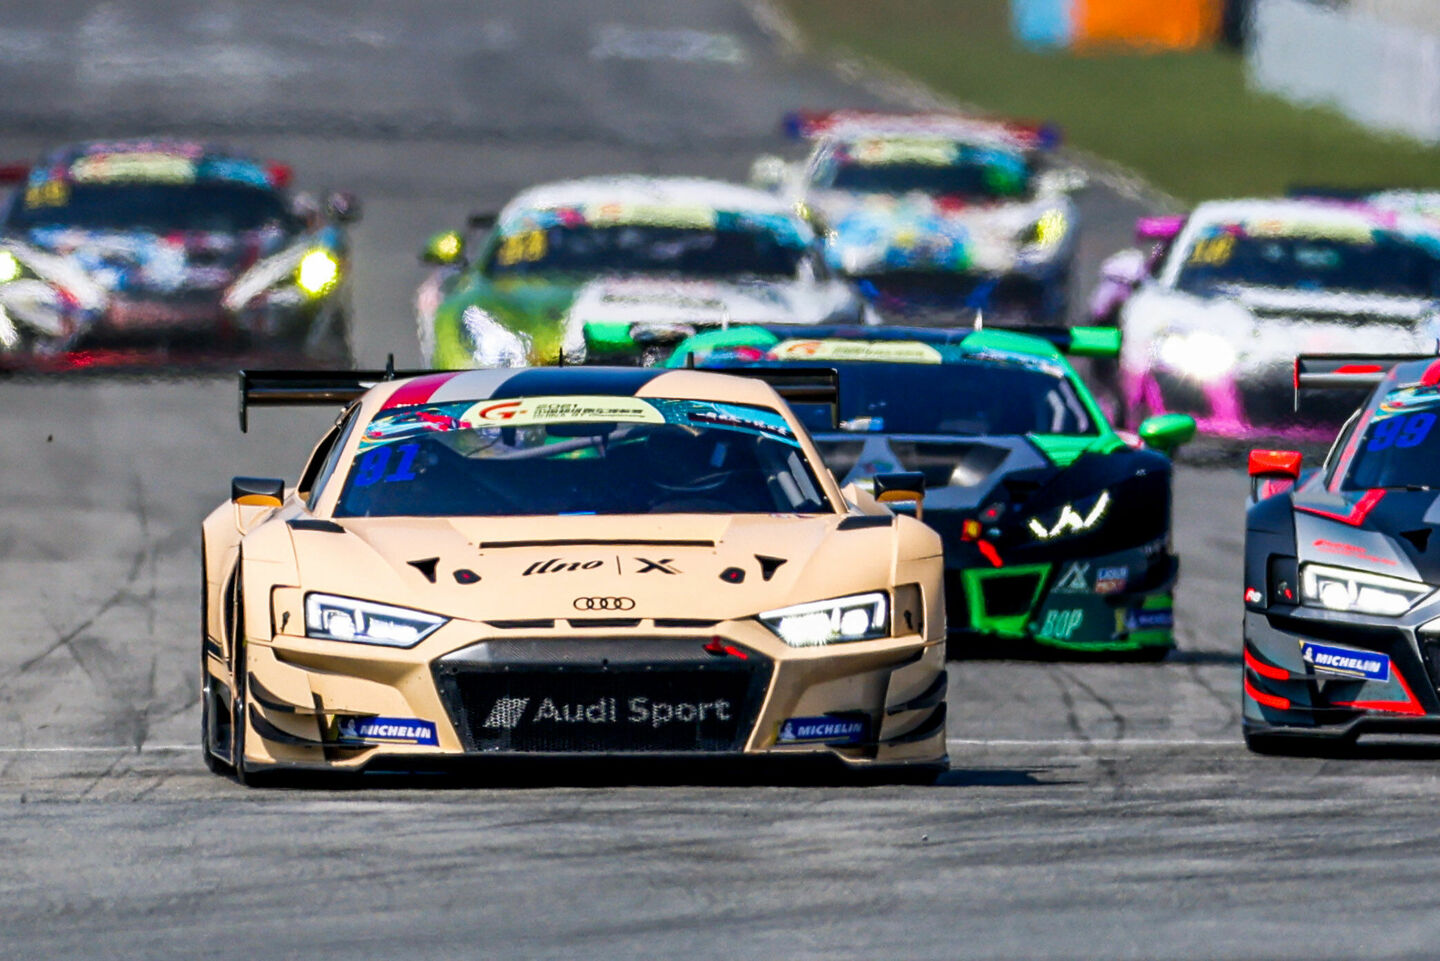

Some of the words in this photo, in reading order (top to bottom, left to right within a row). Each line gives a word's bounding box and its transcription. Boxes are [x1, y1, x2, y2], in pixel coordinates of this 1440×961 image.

[1367, 412, 1437, 452] 99
[354, 443, 420, 487] 91
[1315, 653, 1381, 673] MICHELIN
[532, 697, 617, 722] Audi
[627, 696, 732, 728] Sport
[360, 725, 432, 739] MICHELIN
[797, 722, 863, 737] MICHELIN
